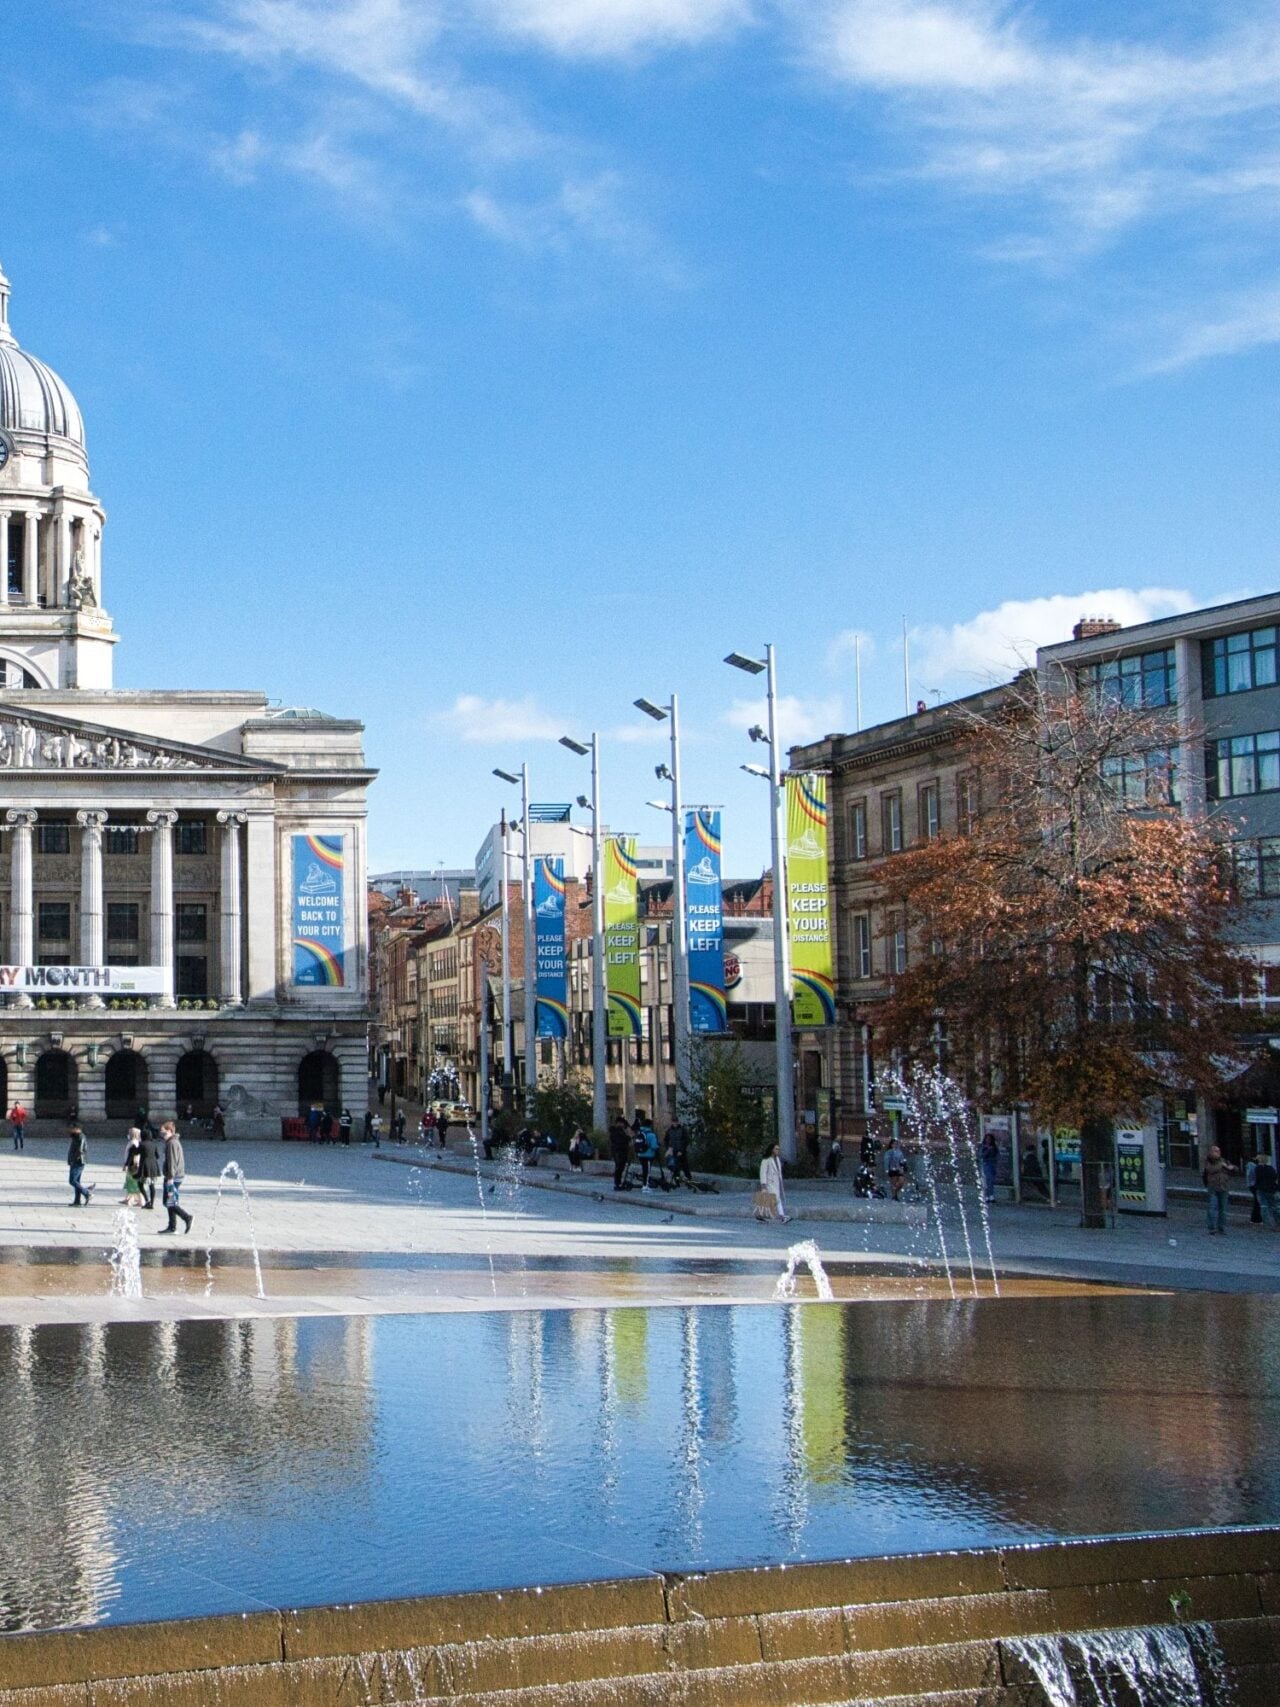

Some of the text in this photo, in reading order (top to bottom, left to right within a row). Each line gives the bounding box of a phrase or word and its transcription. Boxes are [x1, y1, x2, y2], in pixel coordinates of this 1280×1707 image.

[791, 883, 827, 893] PLEASE
[297, 896, 340, 907] WELCOME
[791, 898, 828, 912] KEEP
[689, 905, 720, 914] PLEASE
[301, 910, 337, 921] BACK TO
[607, 922, 635, 931] PLEASE
[689, 920, 721, 932] KEEP
[793, 917, 828, 930] YOUR
[297, 925, 341, 936] YOUR CITY
[537, 934, 563, 942] PLEASE
[608, 936, 636, 947] KEEP
[793, 934, 829, 943] DISTANCE
[690, 938, 721, 951] LEFT
[538, 946, 564, 956] KEEP
[608, 952, 636, 964] LEFT
[538, 960, 564, 969] YOUR
[25, 967, 111, 986] MONTH
